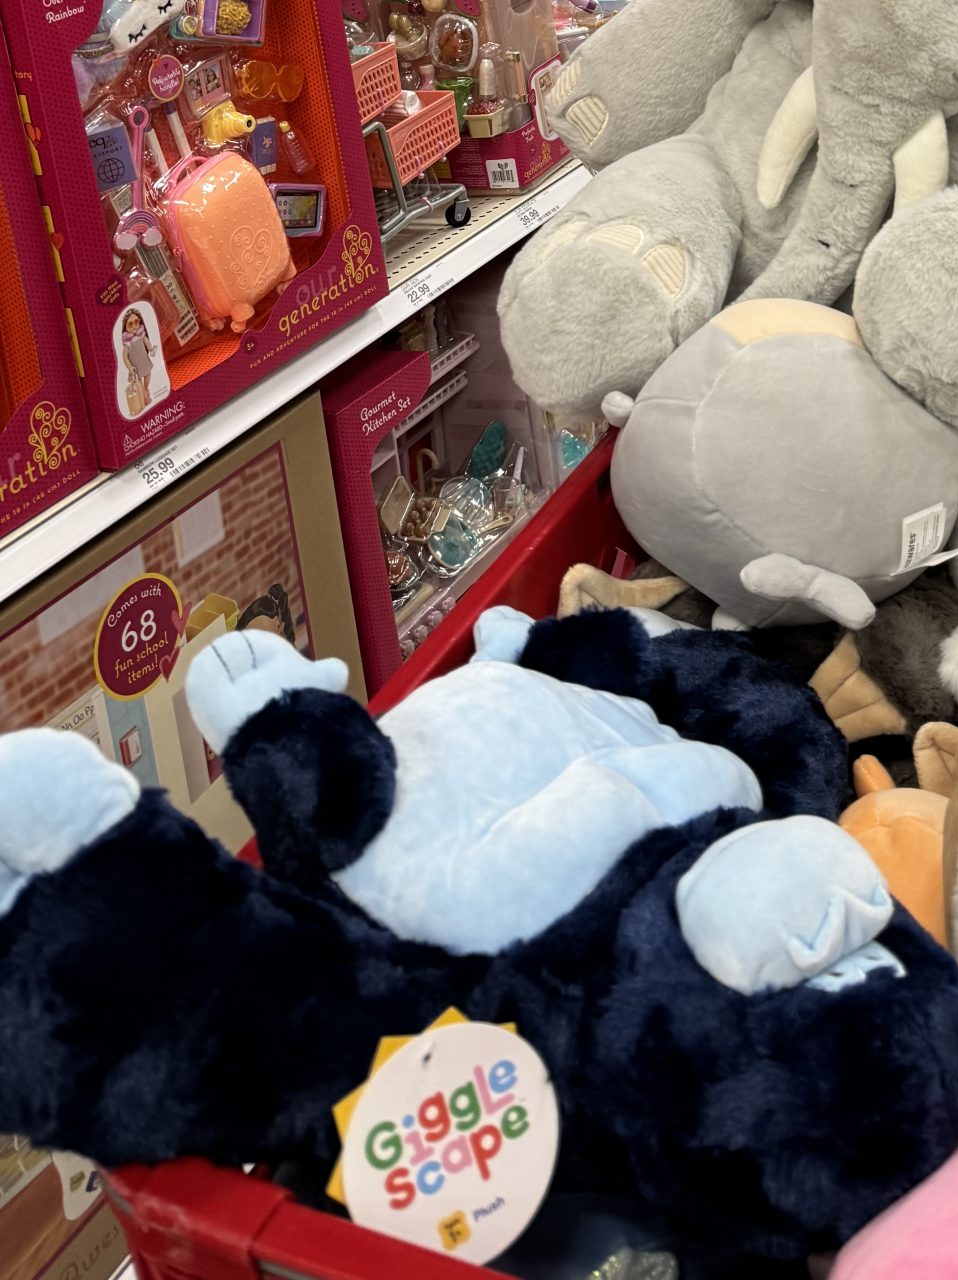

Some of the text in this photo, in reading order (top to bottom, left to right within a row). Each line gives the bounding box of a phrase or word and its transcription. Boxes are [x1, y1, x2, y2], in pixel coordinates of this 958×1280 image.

[45, 5, 85, 24] Rainbow
[15, 70, 32, 81] tory
[520, 209, 540, 226] 39.99
[279, 255, 376, 337] generation
[406, 282, 431, 303] 22.99
[262, 350, 274, 361] AND
[274, 329, 308, 352] ADVENTURE
[307, 321, 319, 331] FOR
[139, 398, 186, 433] WARNING:
[360, 390, 396, 421] Gourmet
[362, 396, 411, 436] Kitchen Set
[62, 470, 80, 484] DOLL
[142, 457, 175, 486] 25.99
[107, 582, 162, 628] Comes with
[121, 609, 157, 653] 68
[114, 631, 169, 678] fun school
[128, 654, 158, 684] items!
[472, 1196, 505, 1221] Plush
